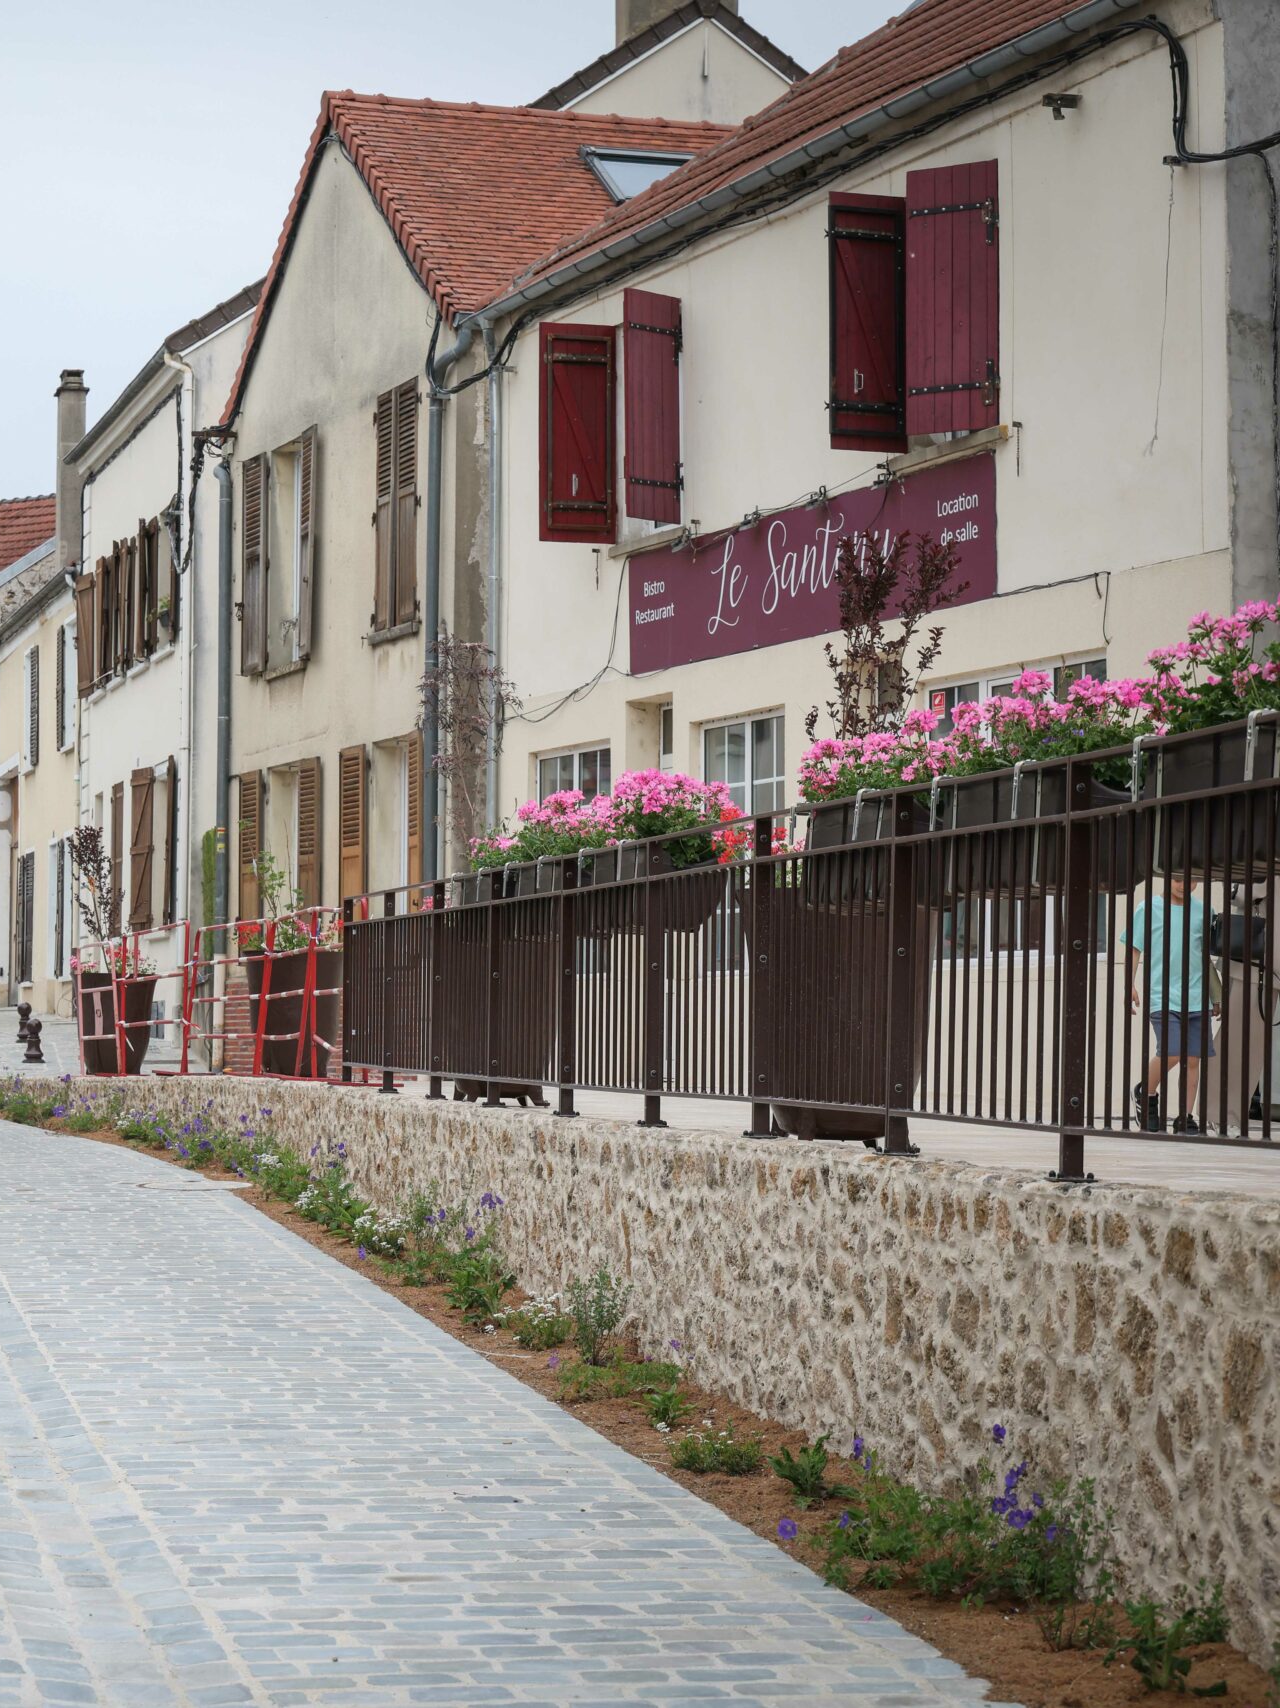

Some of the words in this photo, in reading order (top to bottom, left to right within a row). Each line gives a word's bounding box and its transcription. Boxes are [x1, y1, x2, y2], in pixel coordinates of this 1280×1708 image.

[937, 492, 979, 517] Location
[940, 527, 953, 547] de
[955, 520, 979, 542] salle
[643, 580, 665, 597] Bistro
[708, 534, 749, 635] Le
[635, 602, 675, 625] Restaurant
